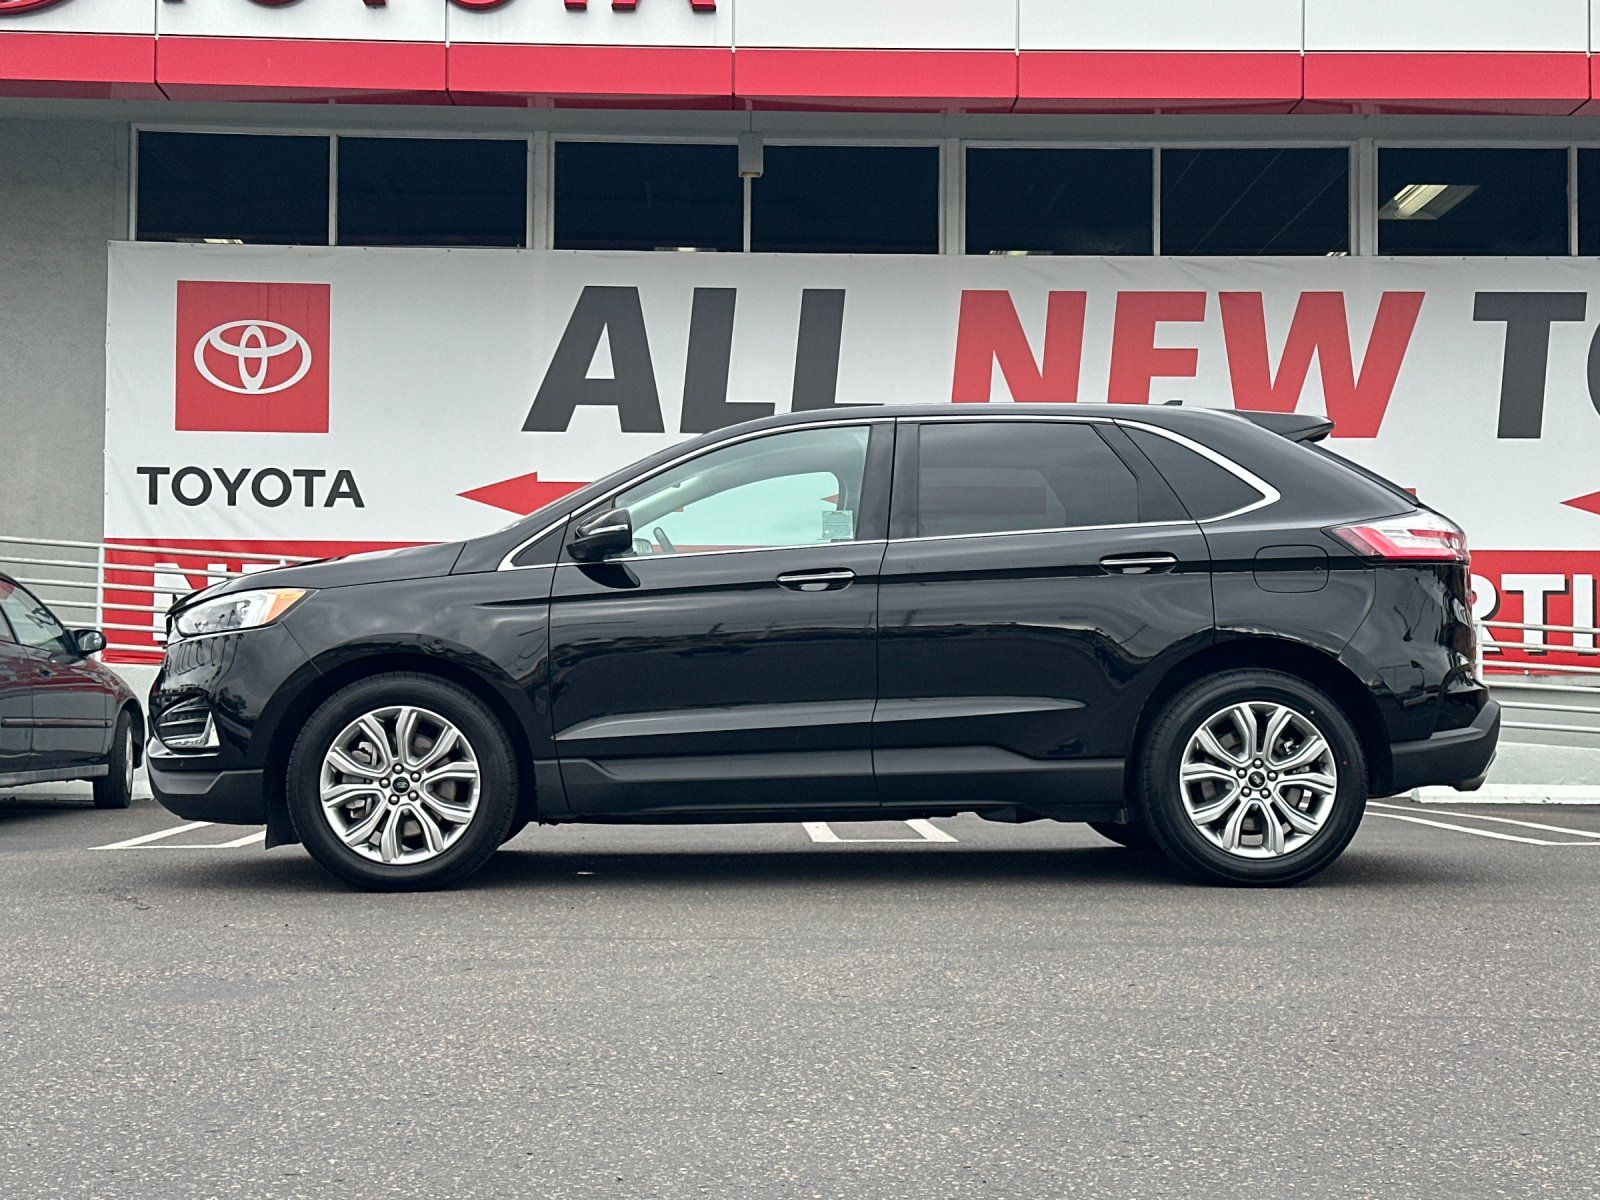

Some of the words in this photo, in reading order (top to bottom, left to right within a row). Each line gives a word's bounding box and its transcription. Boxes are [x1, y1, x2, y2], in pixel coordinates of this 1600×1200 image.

[521, 285, 884, 433] ALL
[951, 289, 1426, 439] NEW
[1472, 291, 1600, 439] T
[136, 466, 365, 508] TOYOTA
